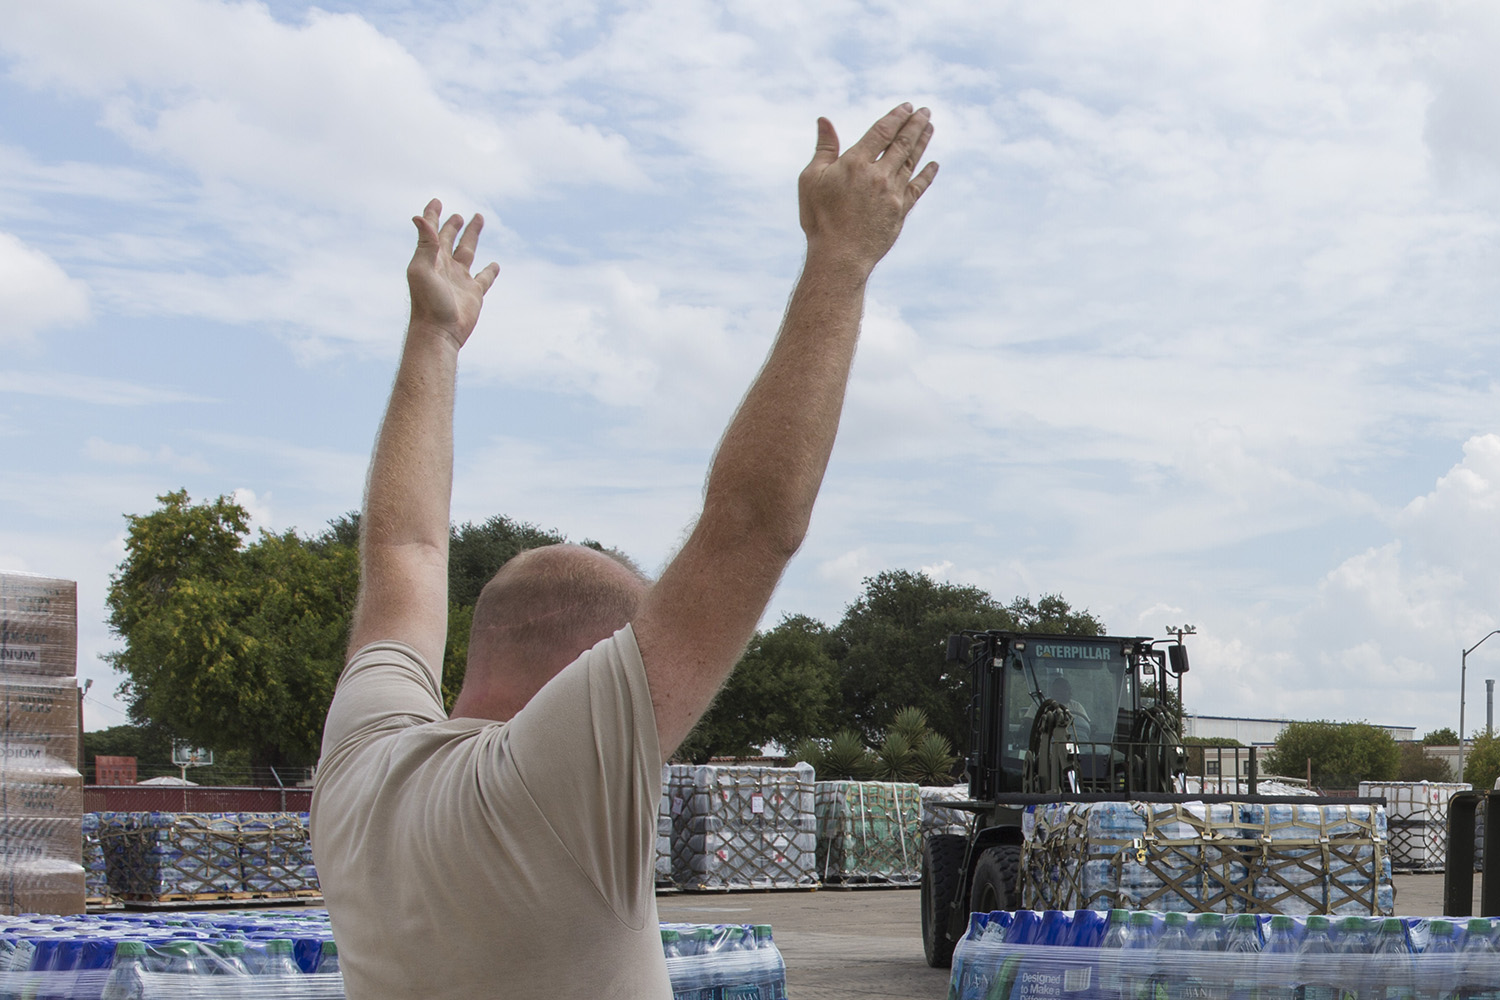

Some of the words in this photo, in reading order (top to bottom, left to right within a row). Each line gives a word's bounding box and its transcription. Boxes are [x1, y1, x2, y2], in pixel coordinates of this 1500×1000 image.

[0, 649, 36, 660] DIUM
[1035, 644, 1111, 660] CATERPILLAR
[0, 747, 41, 759] ODIUM
[1022, 971, 1061, 985] Designed
[1020, 985, 1029, 994] to
[1029, 984, 1055, 996] Make
